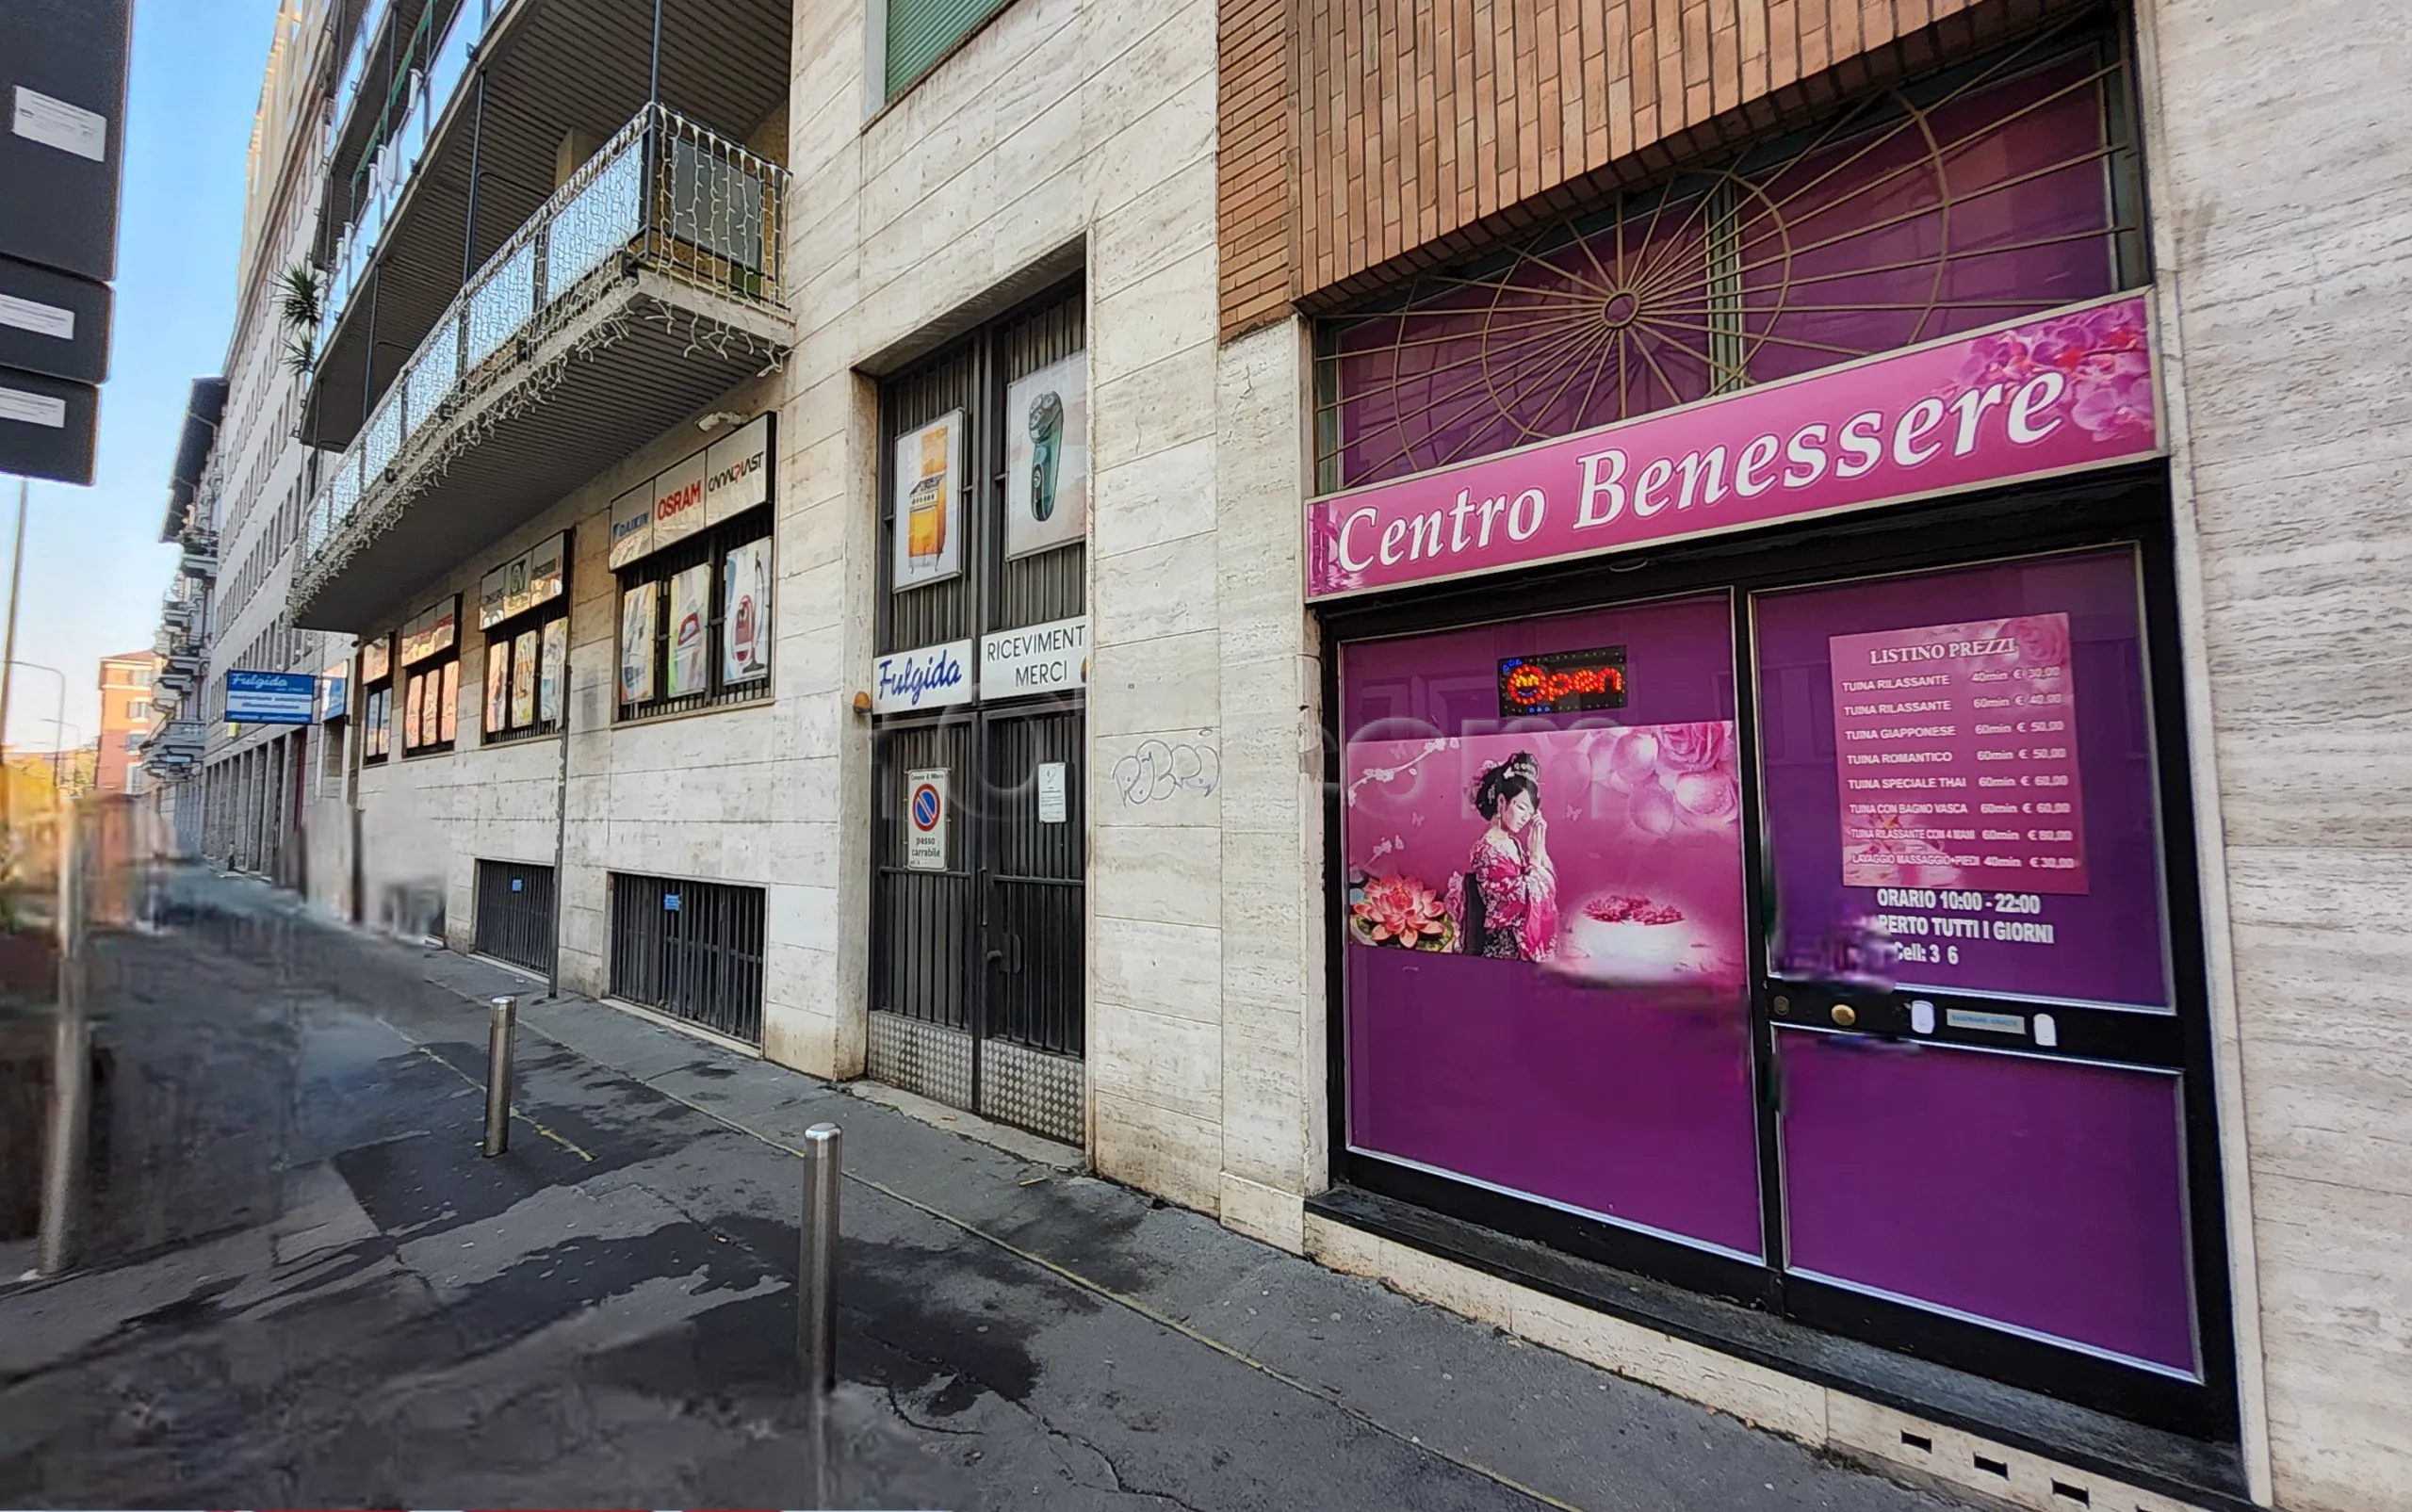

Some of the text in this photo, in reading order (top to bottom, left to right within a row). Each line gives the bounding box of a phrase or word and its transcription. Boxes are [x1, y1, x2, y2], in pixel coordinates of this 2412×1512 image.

[1338, 372, 2066, 572] Centro Benessere
[658, 480, 702, 521] OSRAM
[987, 625, 1086, 661] RICEVIMENT
[1870, 638, 2015, 664] LISTINO PREZZI
[231, 673, 287, 689] Fulgida
[878, 648, 962, 706] Fulgida
[1016, 660, 1067, 688] MERCI
[1508, 663, 1622, 705] Open
[1843, 681, 1875, 691] TUINA
[1877, 675, 1949, 689] RILASSANTE
[2013, 669, 2022, 679] €
[1844, 706, 1877, 716] TUINA
[1879, 700, 1951, 714] RILASSANTE
[2014, 695, 2024, 706] €
[1845, 730, 1879, 740] TUINA
[1881, 725, 1956, 739] GIAPPONESE
[2016, 722, 2027, 733] €
[1847, 755, 1881, 764] TUINA
[1882, 752, 1952, 763] ROMANTICO
[2018, 749, 2028, 759] €
[1848, 779, 1881, 789] TUINA
[1882, 777, 1937, 789] SPECIALE
[1939, 777, 1966, 788] THAI
[2020, 775, 2030, 787] €
[1877, 804, 1898, 814] CON
[1899, 804, 1932, 814] BAGNO
[1934, 804, 1968, 813] VASCA
[2022, 803, 2032, 814] €
[916, 837, 936, 847] passo
[1876, 829, 1925, 839] RILASSANTE
[911, 848, 940, 857] carrabile
[1852, 854, 1895, 864] LAVAGGIO
[1877, 888, 1936, 909] ORARIO
[1940, 890, 1982, 911] 10:00
[1994, 893, 2041, 914] 22:00
[1875, 914, 2055, 944] PERTO TUTTI I GIORNI
